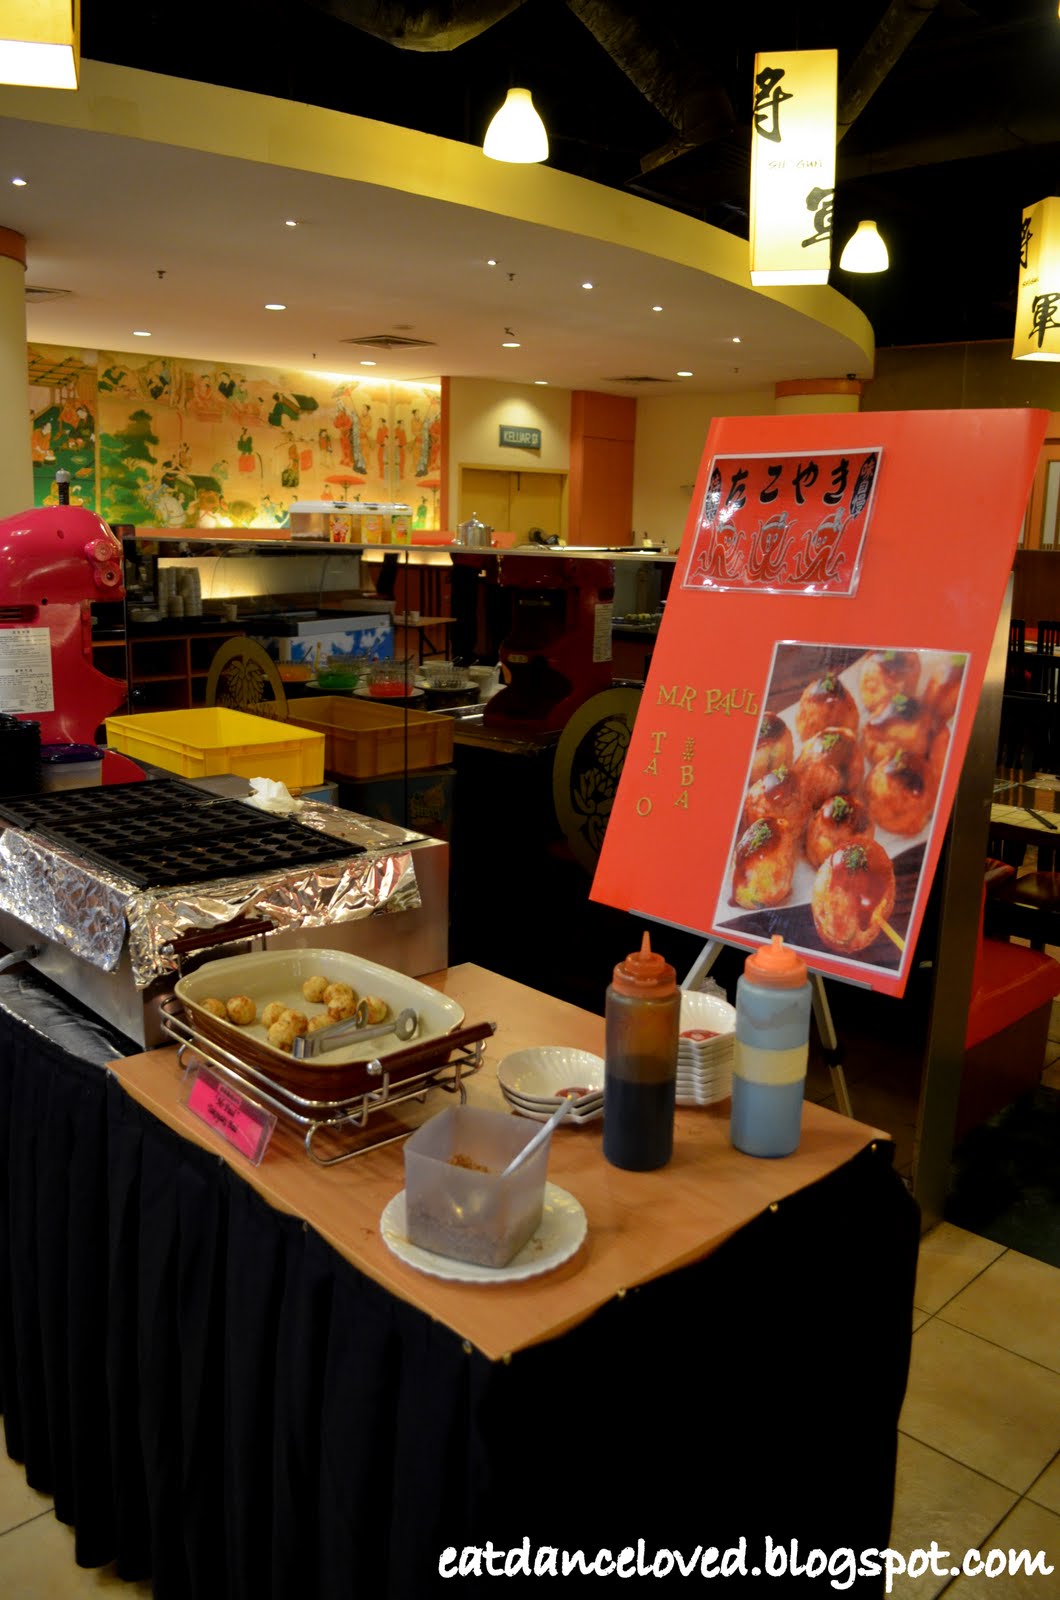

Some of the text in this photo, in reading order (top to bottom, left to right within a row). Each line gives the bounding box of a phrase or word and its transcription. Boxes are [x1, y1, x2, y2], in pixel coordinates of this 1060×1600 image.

[725, 457, 850, 509] たこやき
[656, 685, 758, 716] MR PAUL
